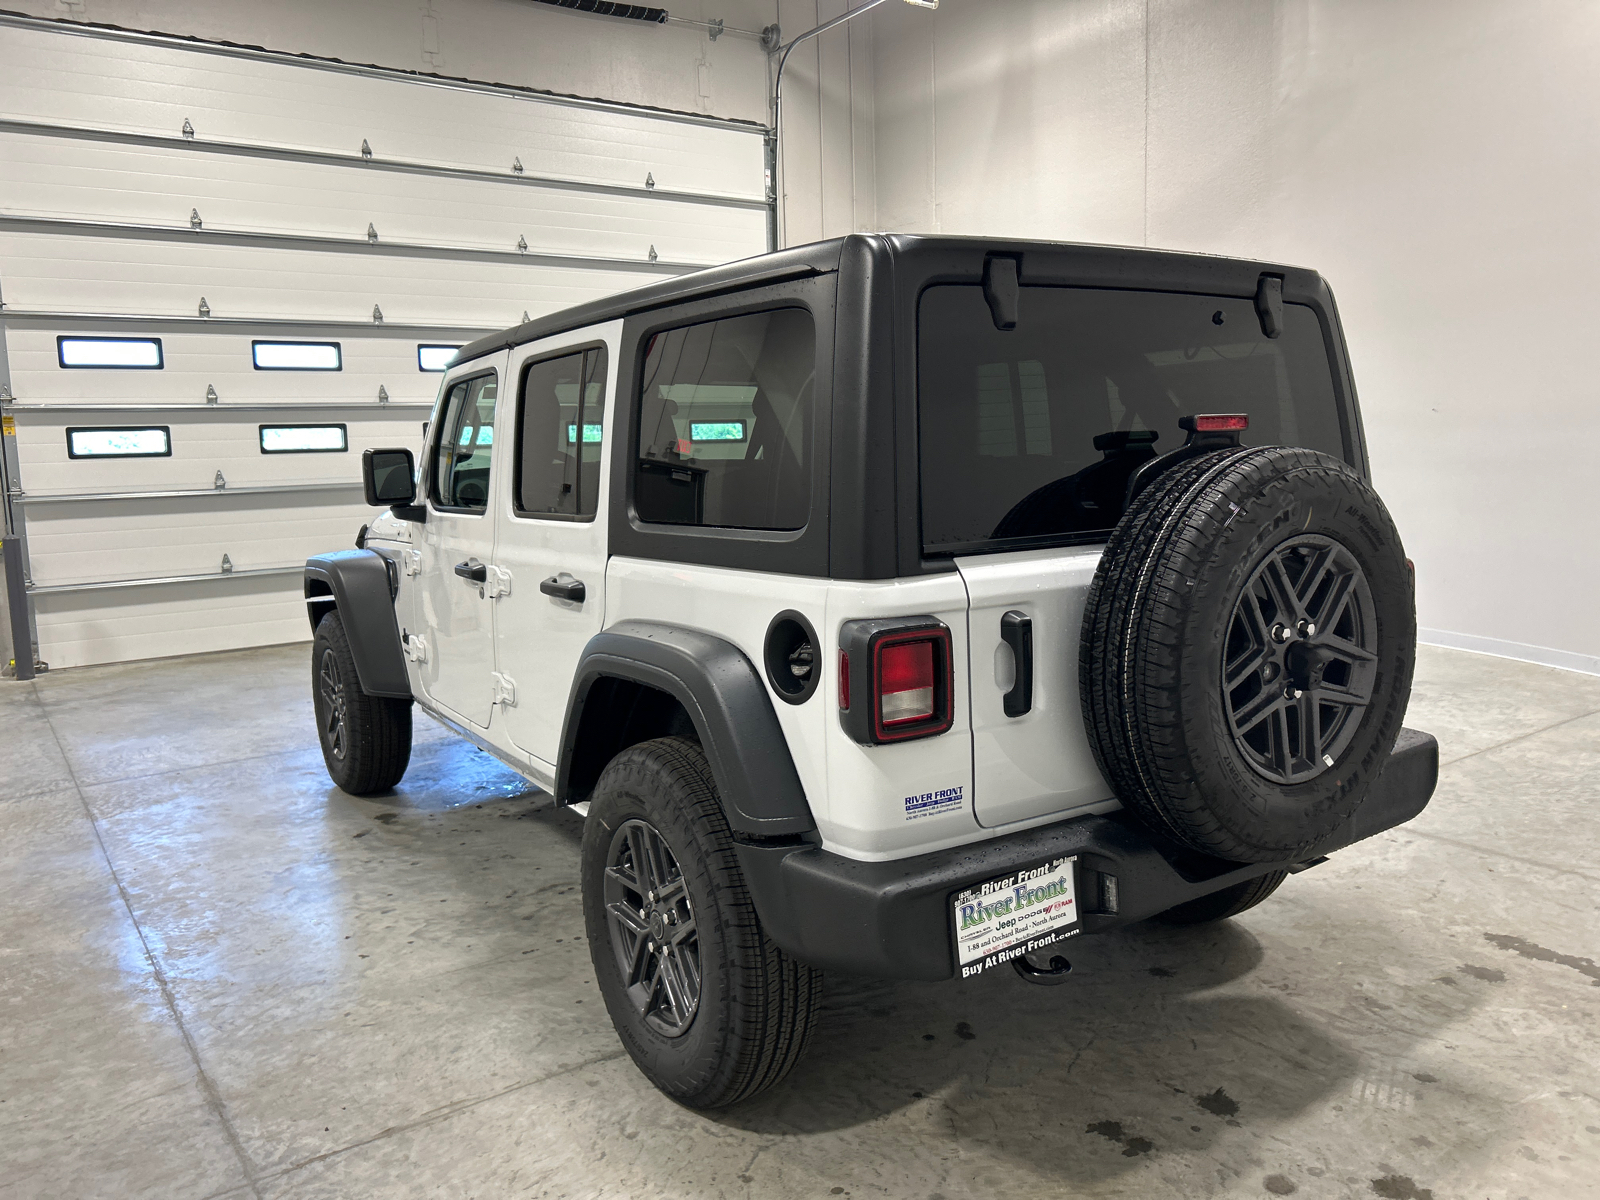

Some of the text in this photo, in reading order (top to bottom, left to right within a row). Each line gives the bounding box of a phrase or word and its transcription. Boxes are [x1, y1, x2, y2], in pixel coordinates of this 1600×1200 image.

[905, 786, 963, 805] RIVER FRONT
[981, 863, 1050, 896] River Front
[959, 876, 1068, 931] River Front
[995, 918, 1016, 931] Jeep
[1018, 907, 1048, 922] DODGE
[1062, 899, 1073, 907] RAM
[981, 938, 991, 947] and
[992, 929, 1014, 943] Orchard
[1014, 923, 1029, 934] Road
[1032, 917, 1048, 927] North
[1049, 912, 1067, 921] Aurora
[962, 963, 983, 978] Buy
[984, 955, 997, 970] At
[998, 945, 1027, 964] River
